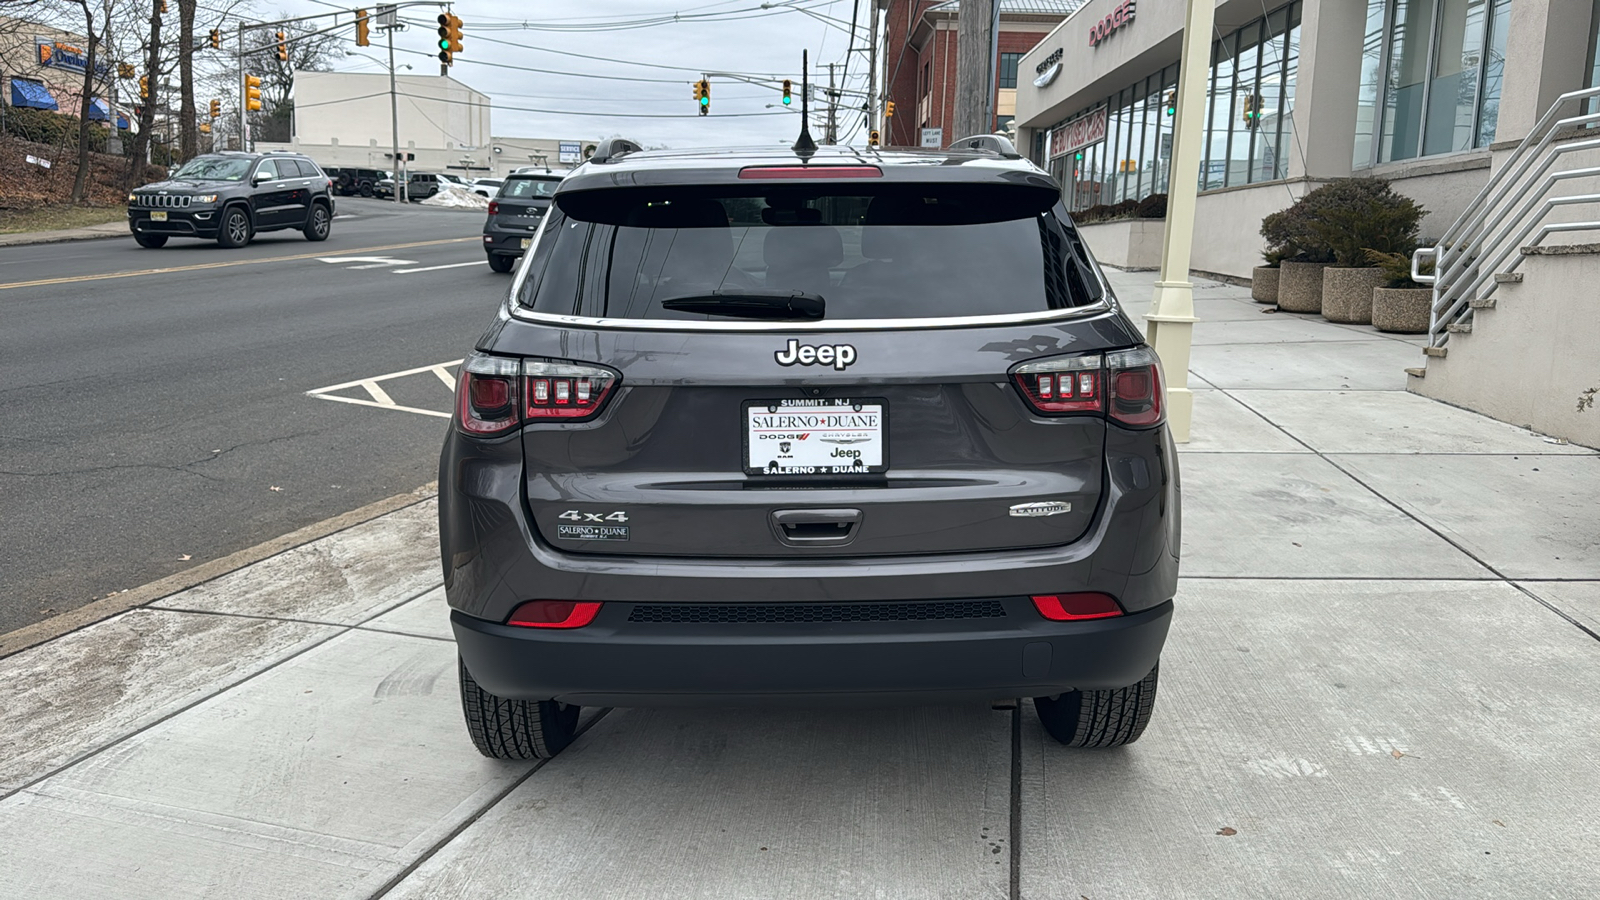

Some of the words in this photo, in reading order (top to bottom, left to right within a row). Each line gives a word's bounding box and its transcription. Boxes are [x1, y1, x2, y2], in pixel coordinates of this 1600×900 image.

[1089, 0, 1134, 46] DODGE
[774, 339, 857, 370] Jeep
[752, 415, 819, 429] SALERNO
[827, 415, 878, 428] DUANE
[830, 447, 862, 460] Jeep
[763, 466, 815, 475] SALERNO
[832, 465, 870, 474] DUANE
[558, 510, 629, 523] 4x4
[1016, 506, 1064, 514] LATITUDE
[559, 526, 594, 534] SALERNO
